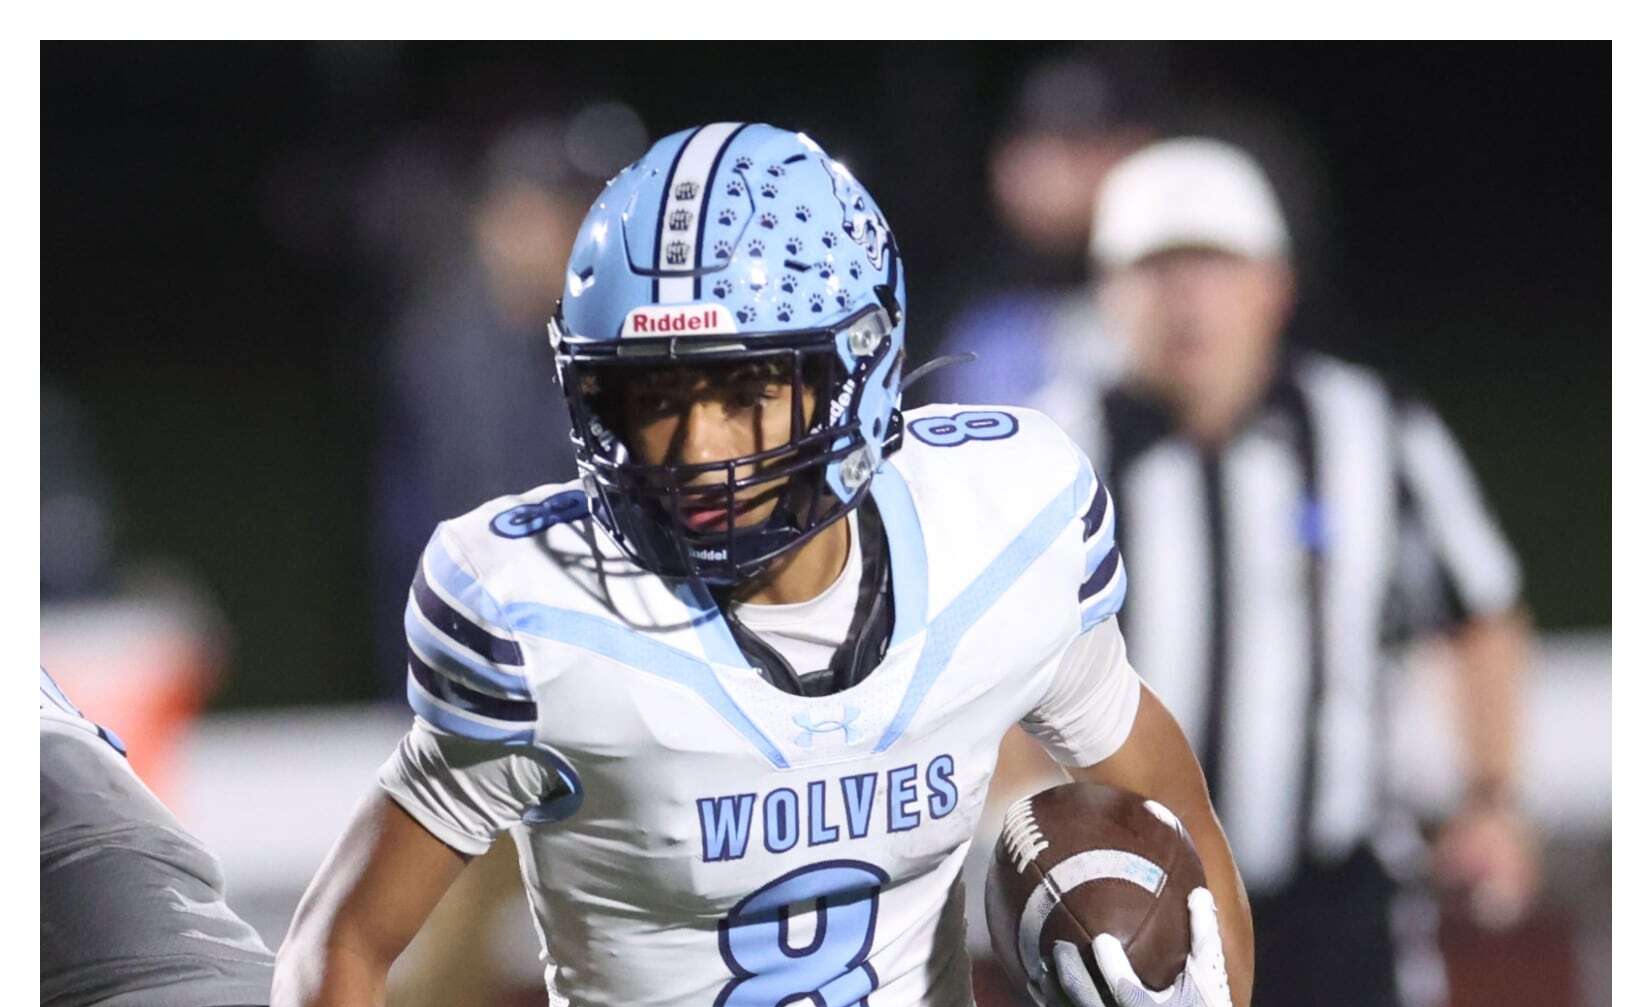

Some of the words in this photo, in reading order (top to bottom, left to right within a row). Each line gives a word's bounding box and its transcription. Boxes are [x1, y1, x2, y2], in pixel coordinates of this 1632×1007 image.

[633, 310, 717, 333] Riddell
[906, 411, 1019, 447] 8
[489, 489, 592, 539] 8
[697, 754, 958, 863] WOLVES
